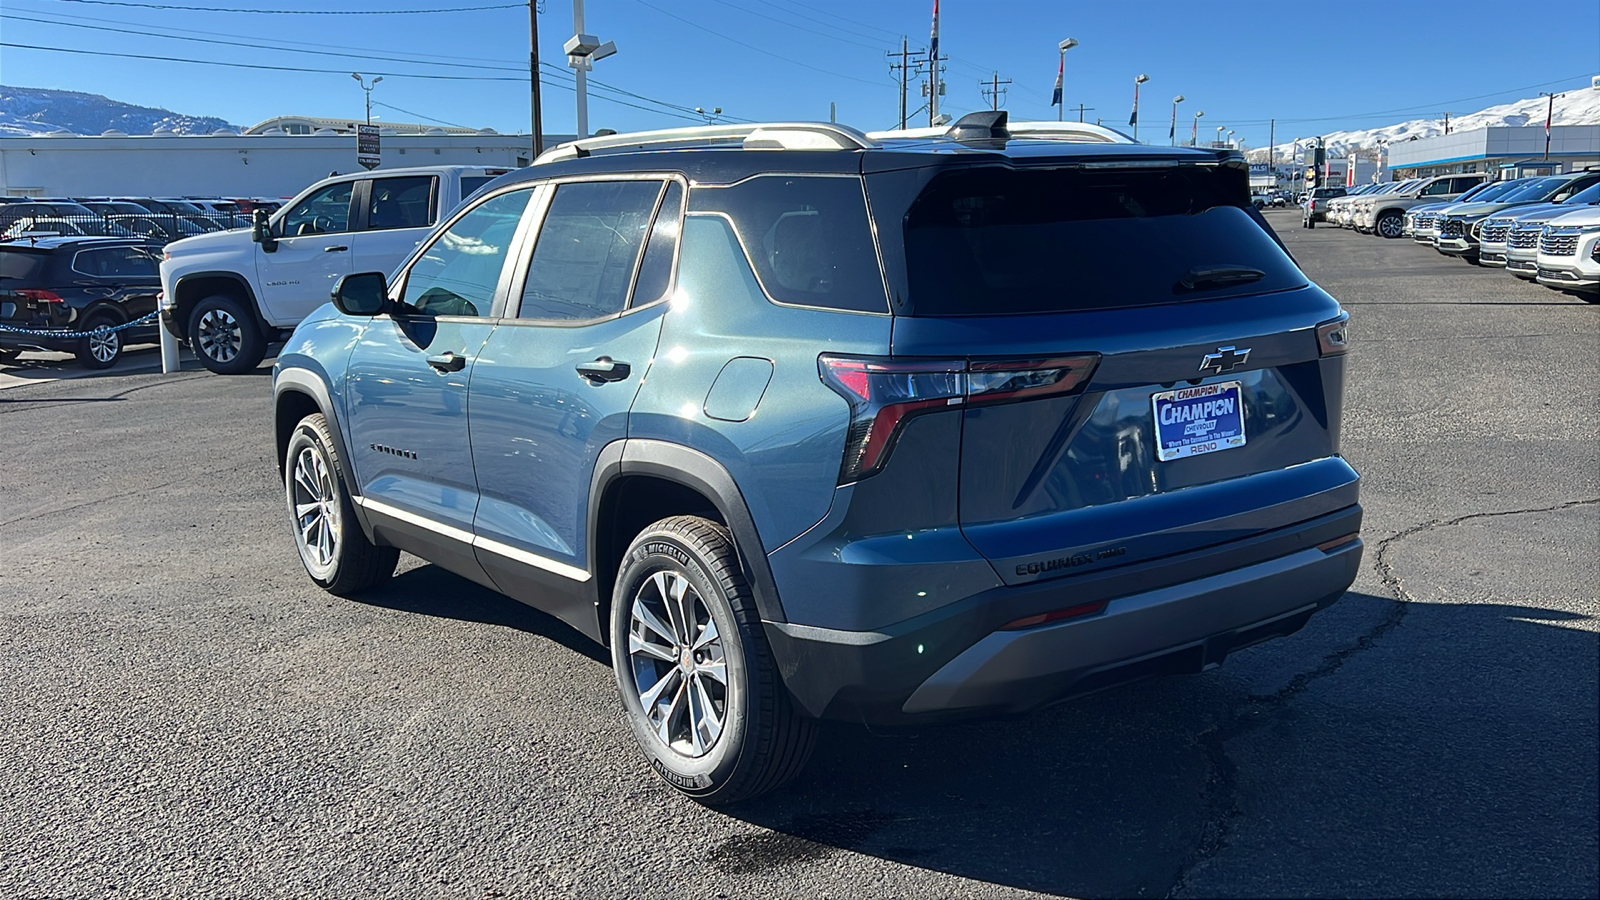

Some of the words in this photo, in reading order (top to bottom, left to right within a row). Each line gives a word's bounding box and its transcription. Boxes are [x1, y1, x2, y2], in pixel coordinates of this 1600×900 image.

[1178, 385, 1218, 399] CHAMPION
[1160, 398, 1234, 425] CHAMPION
[1186, 422, 1215, 432] CHEVROLET
[1190, 442, 1217, 454] RENO
[648, 542, 688, 564] MICHELIN
[1016, 554, 1093, 575] EQUINOX
[655, 760, 694, 787] MICHELIN
